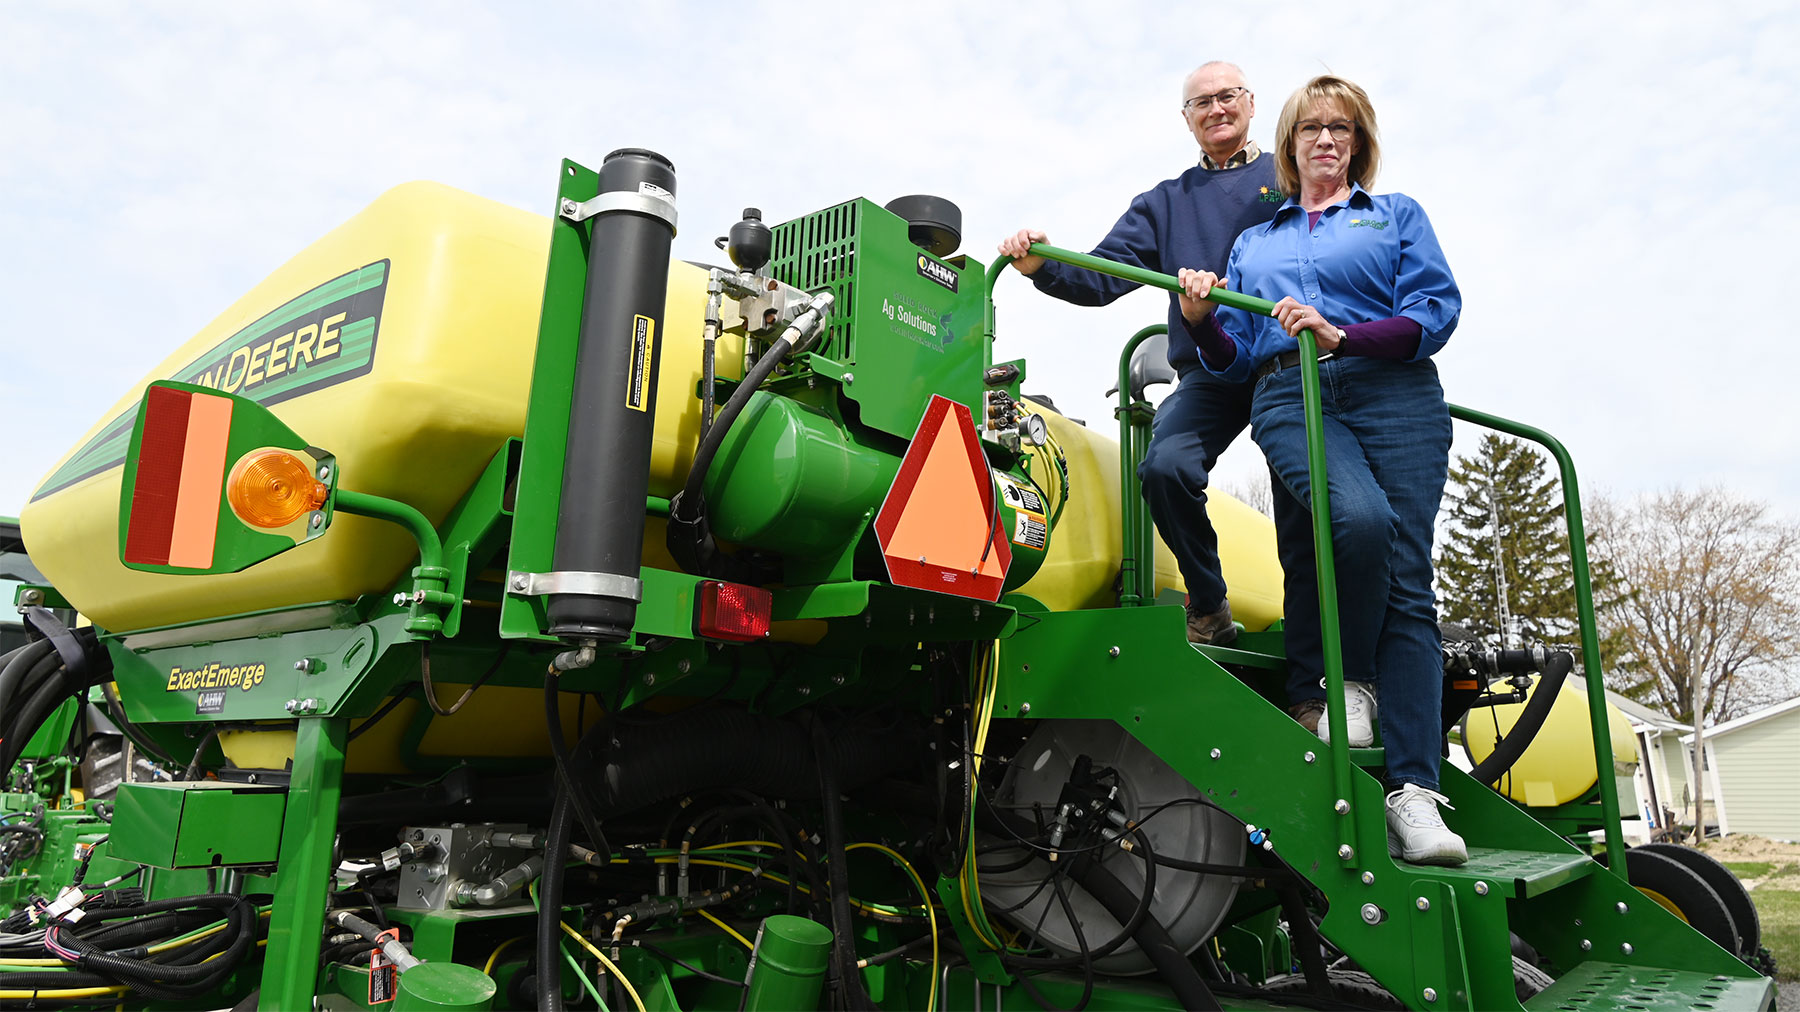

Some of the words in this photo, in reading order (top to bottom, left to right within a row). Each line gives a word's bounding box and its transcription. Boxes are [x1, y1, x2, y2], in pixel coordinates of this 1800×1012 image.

[927, 261, 956, 285] AHW
[882, 298, 895, 320] Ag
[897, 305, 937, 336] Solutions
[222, 312, 347, 393] DEERE
[166, 663, 265, 690] ExactEmerge
